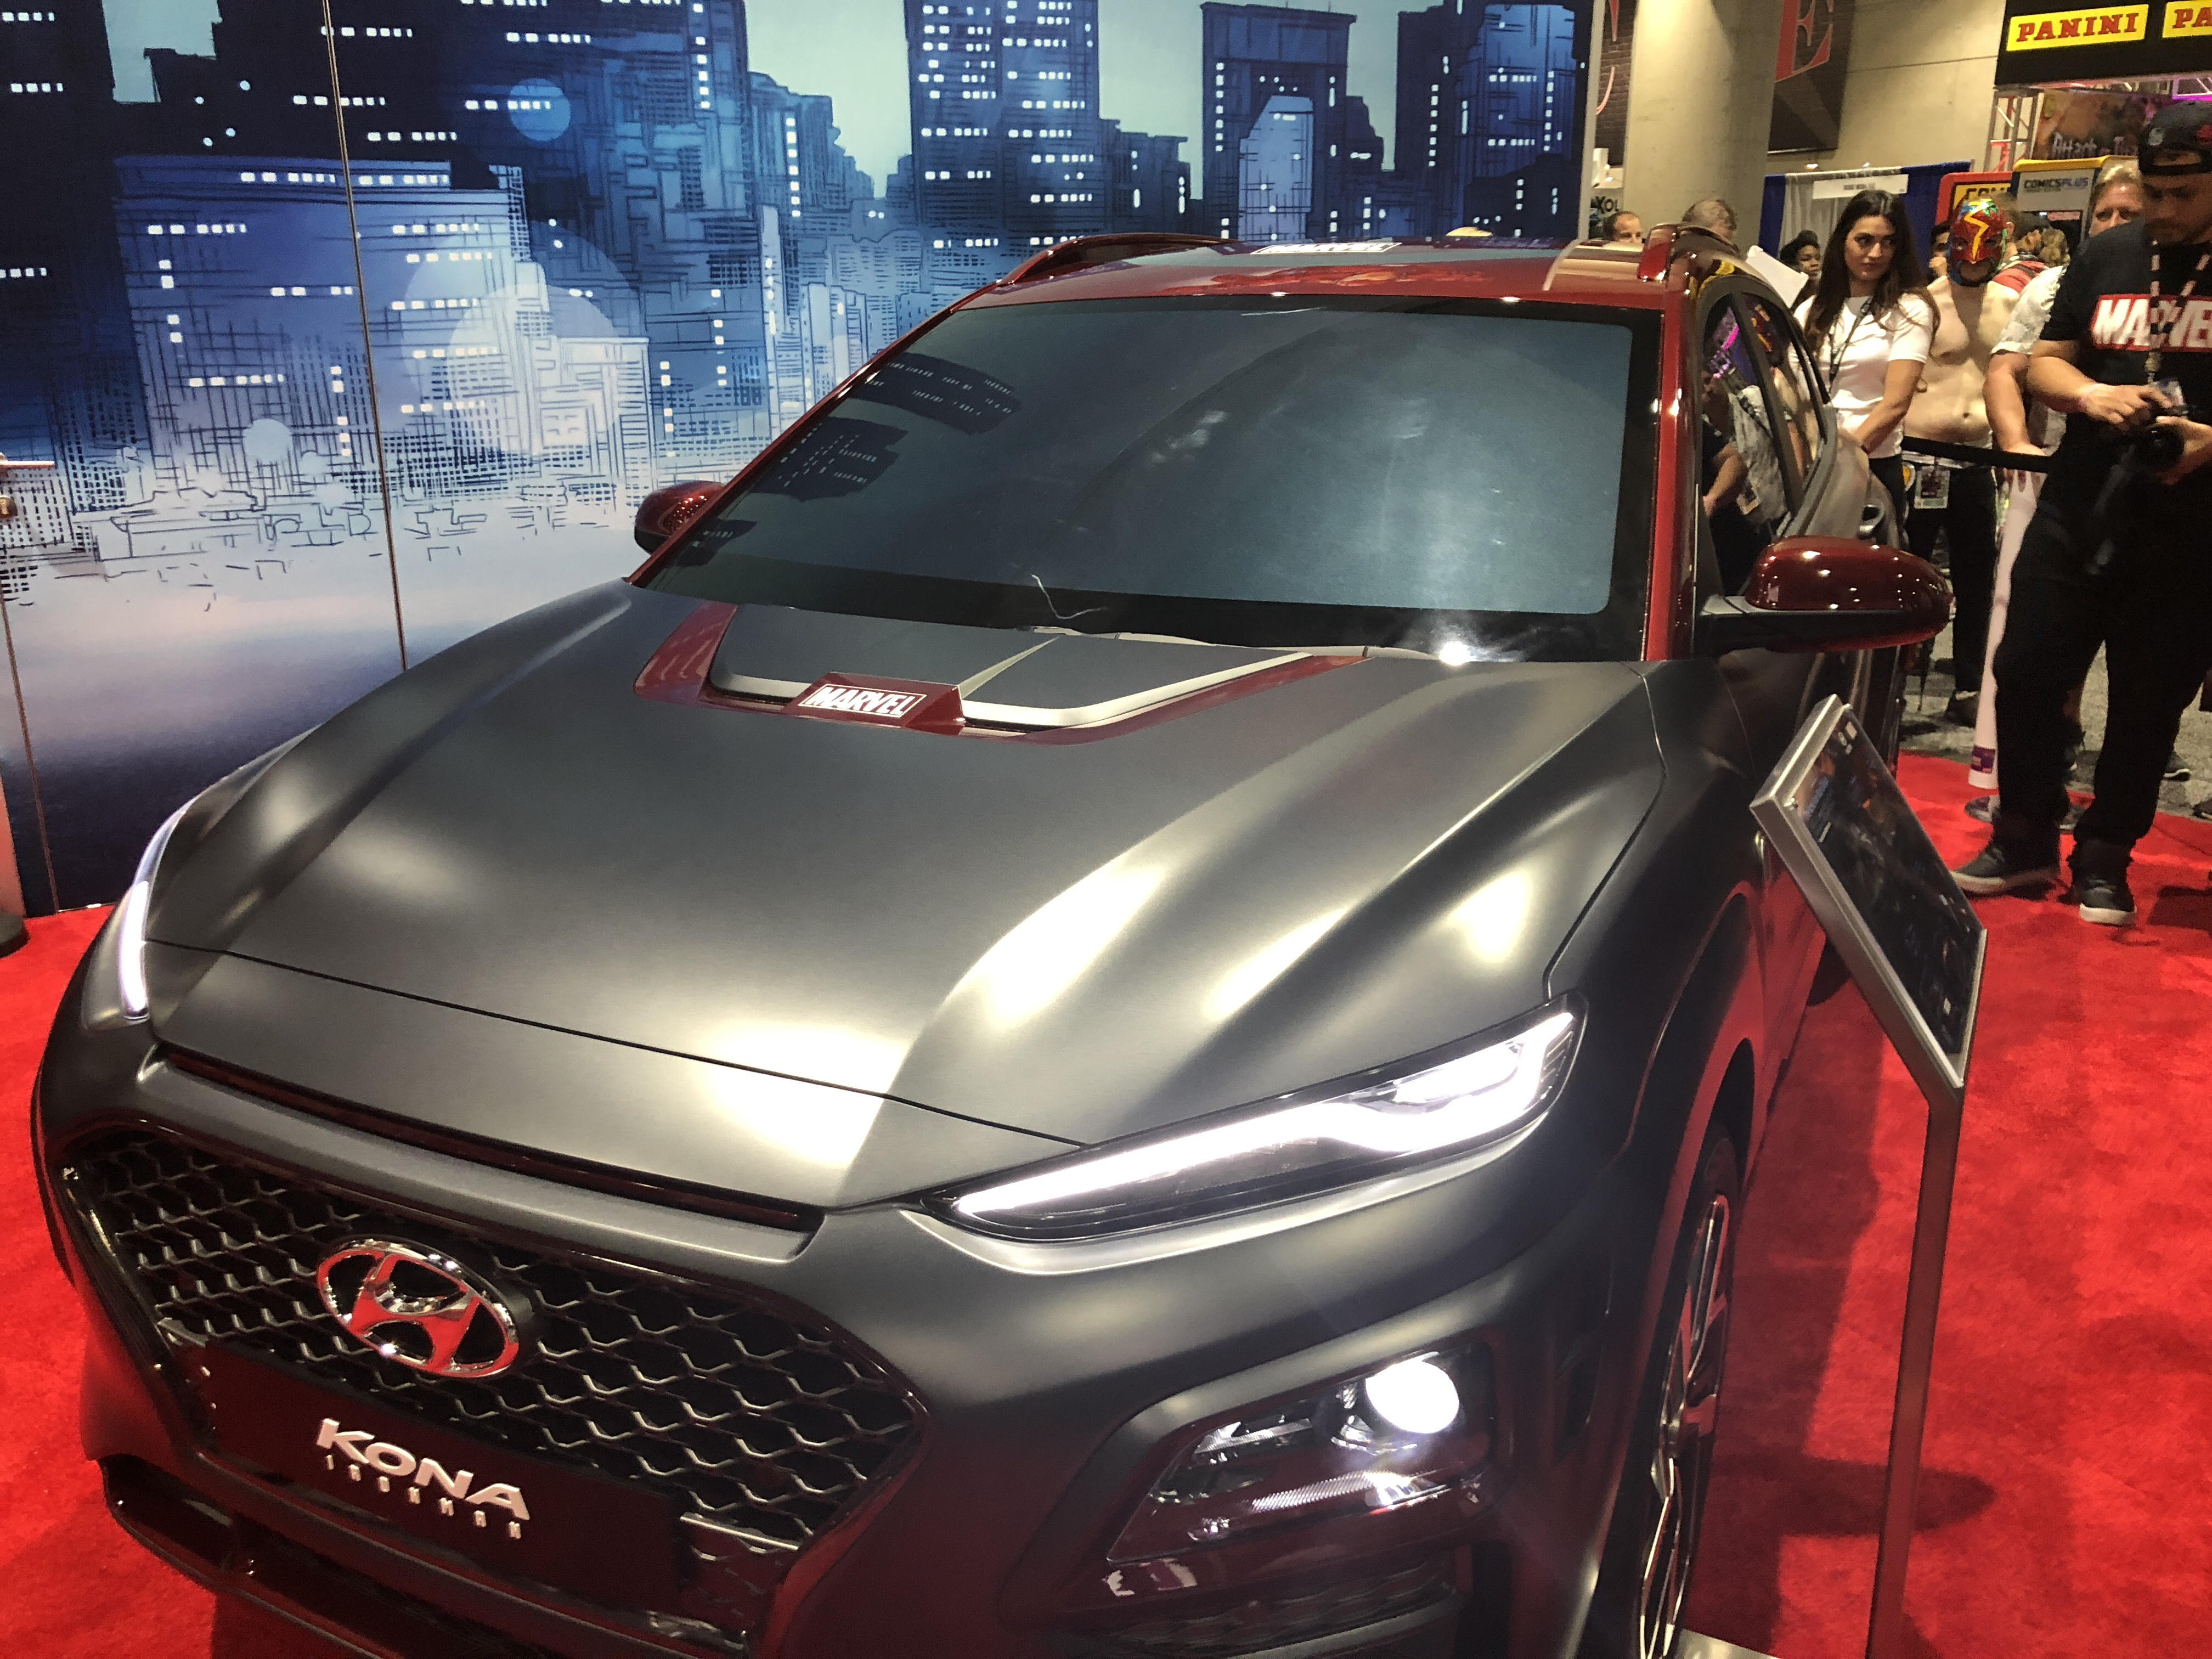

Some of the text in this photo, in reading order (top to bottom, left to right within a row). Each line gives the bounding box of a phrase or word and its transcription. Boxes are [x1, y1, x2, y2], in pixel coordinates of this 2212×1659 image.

[2016, 13, 2140, 42] PANINI
[804, 687, 916, 714] MARVEL
[317, 1418, 531, 1521] KONA
